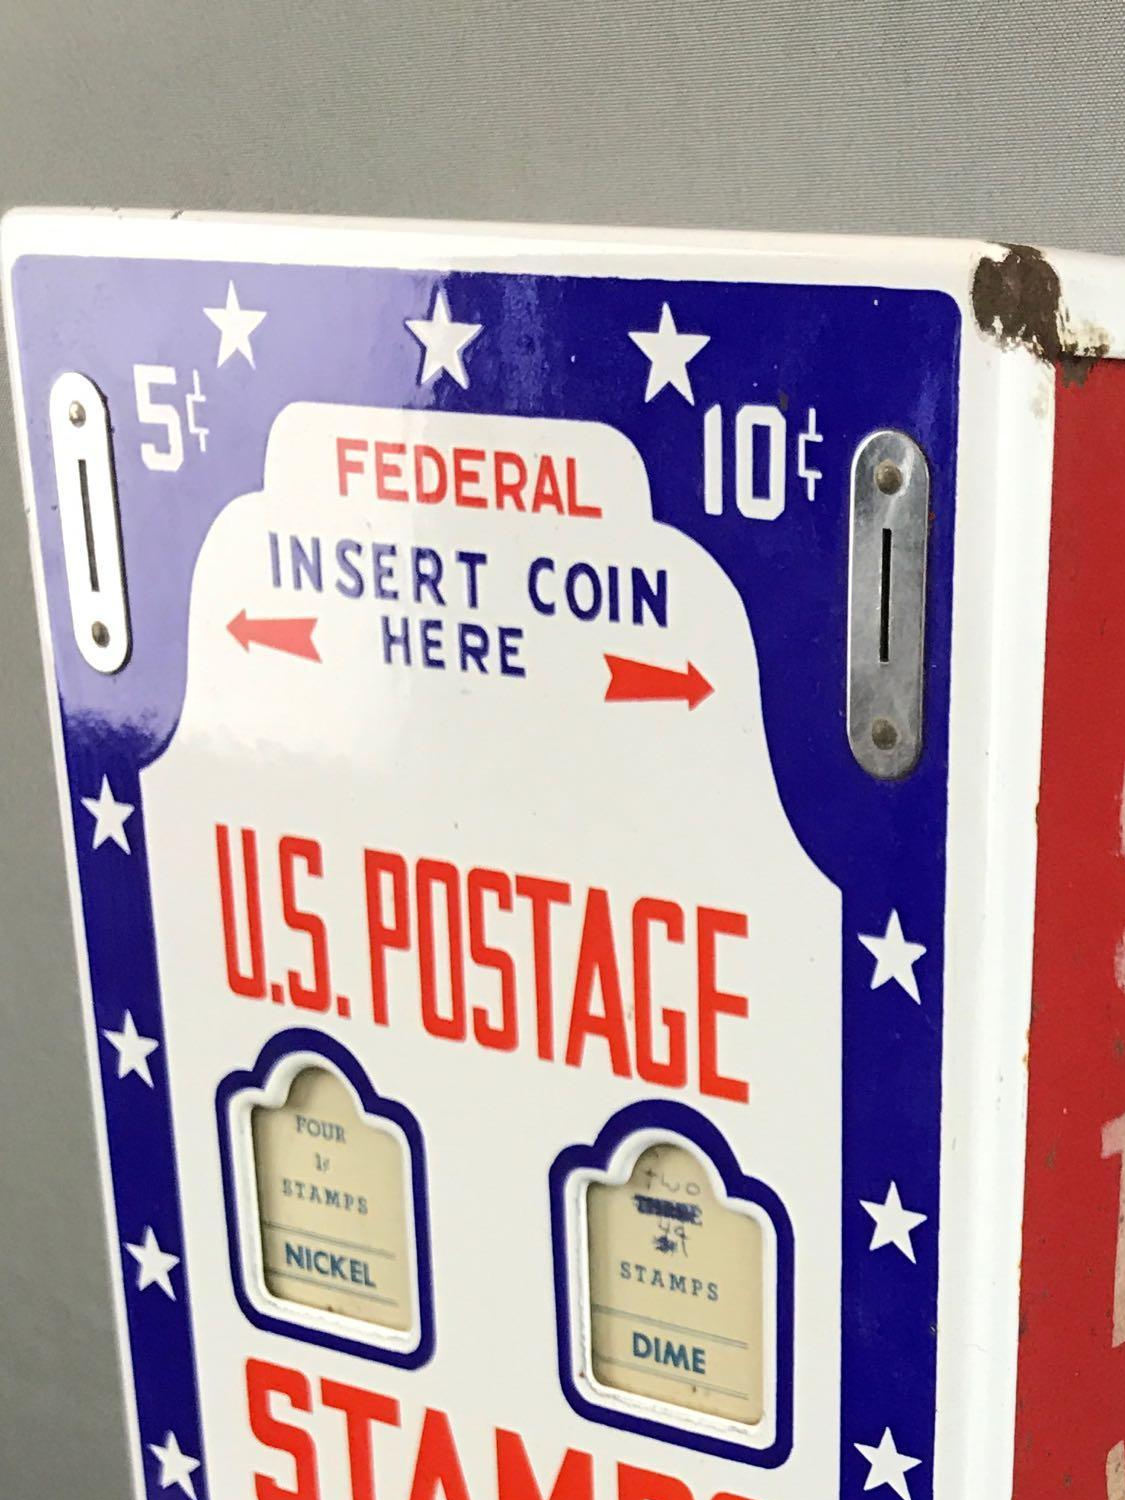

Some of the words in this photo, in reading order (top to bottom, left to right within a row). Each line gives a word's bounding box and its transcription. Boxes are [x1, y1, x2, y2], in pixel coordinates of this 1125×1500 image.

[133, 363, 210, 473] 5¢
[336, 436, 603, 519] FEDERAL
[703, 403, 824, 521] 10¢
[267, 531, 488, 609] INSERT
[527, 556, 668, 628] COIN
[382, 615, 527, 678] HERE
[215, 823, 352, 1019] U.S.
[364, 847, 750, 1105] POSTAGE
[295, 1113, 347, 1144] FOUR
[282, 1178, 369, 1216] STAMPS
[283, 1241, 377, 1288] NICKEL
[620, 1260, 719, 1301] STAMPS
[632, 1331, 706, 1375] DIME
